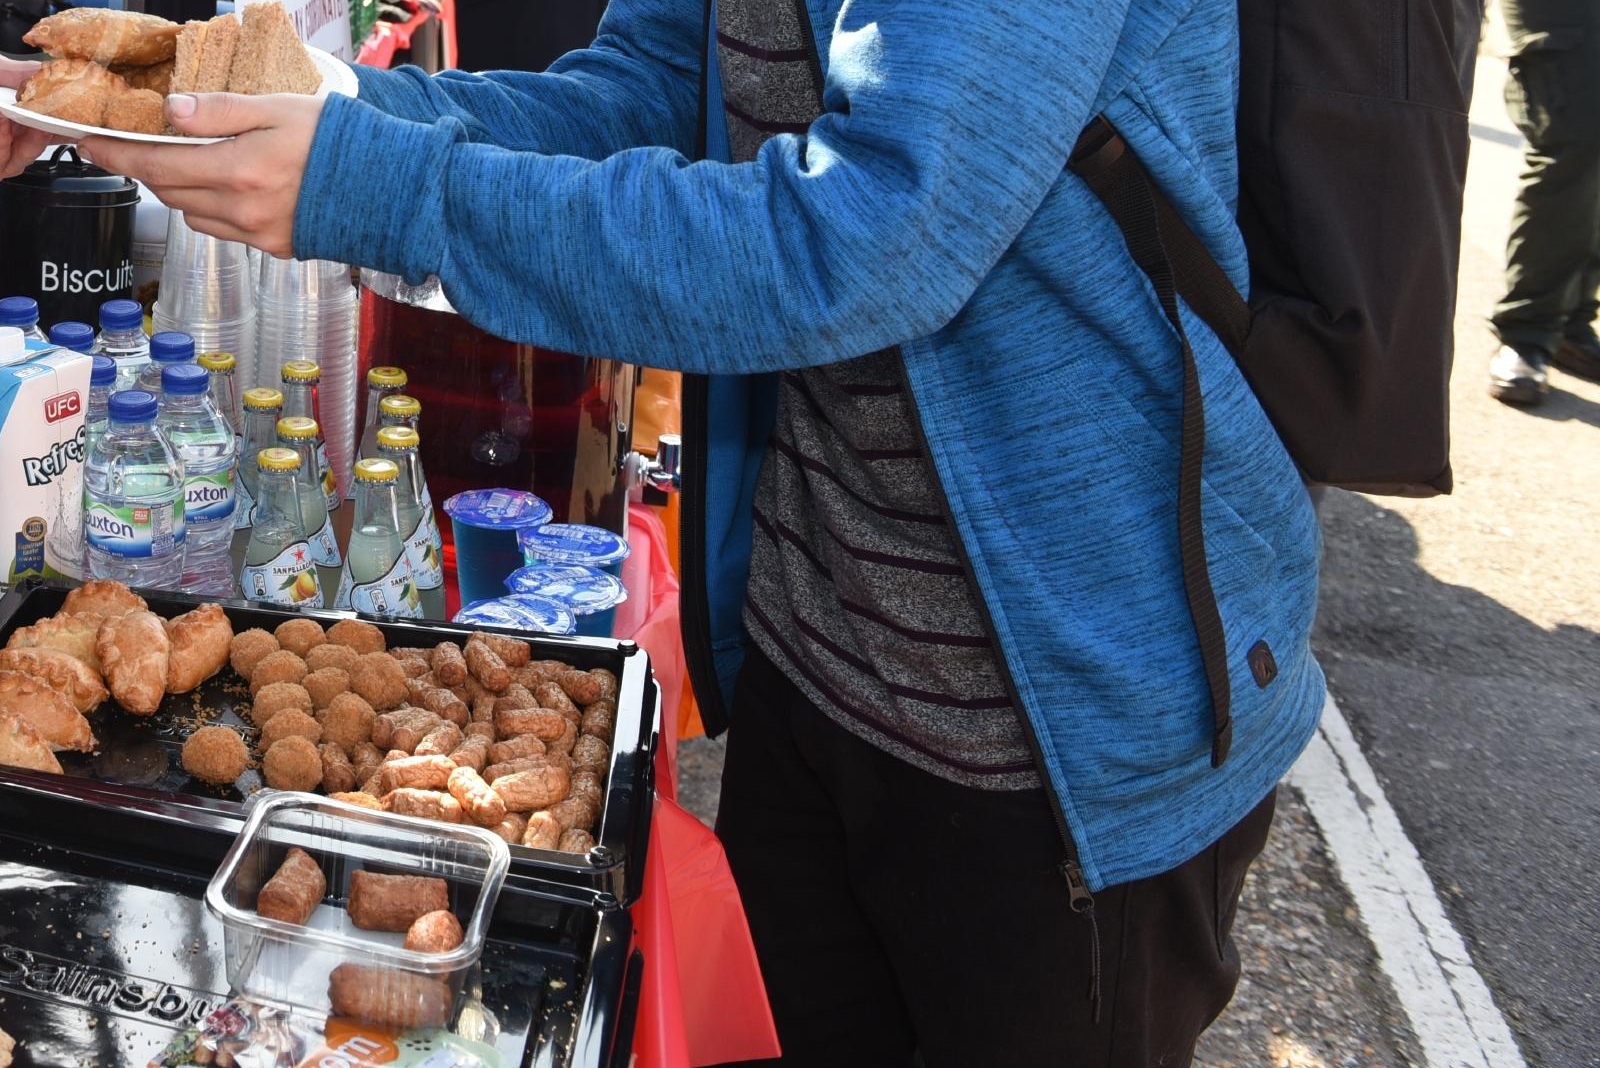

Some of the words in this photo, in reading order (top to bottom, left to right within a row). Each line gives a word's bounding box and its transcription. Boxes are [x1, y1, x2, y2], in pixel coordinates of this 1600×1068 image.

[41, 260, 133, 293] Biscuits
[47, 396, 79, 418] UFC
[23, 425, 86, 486] Refres
